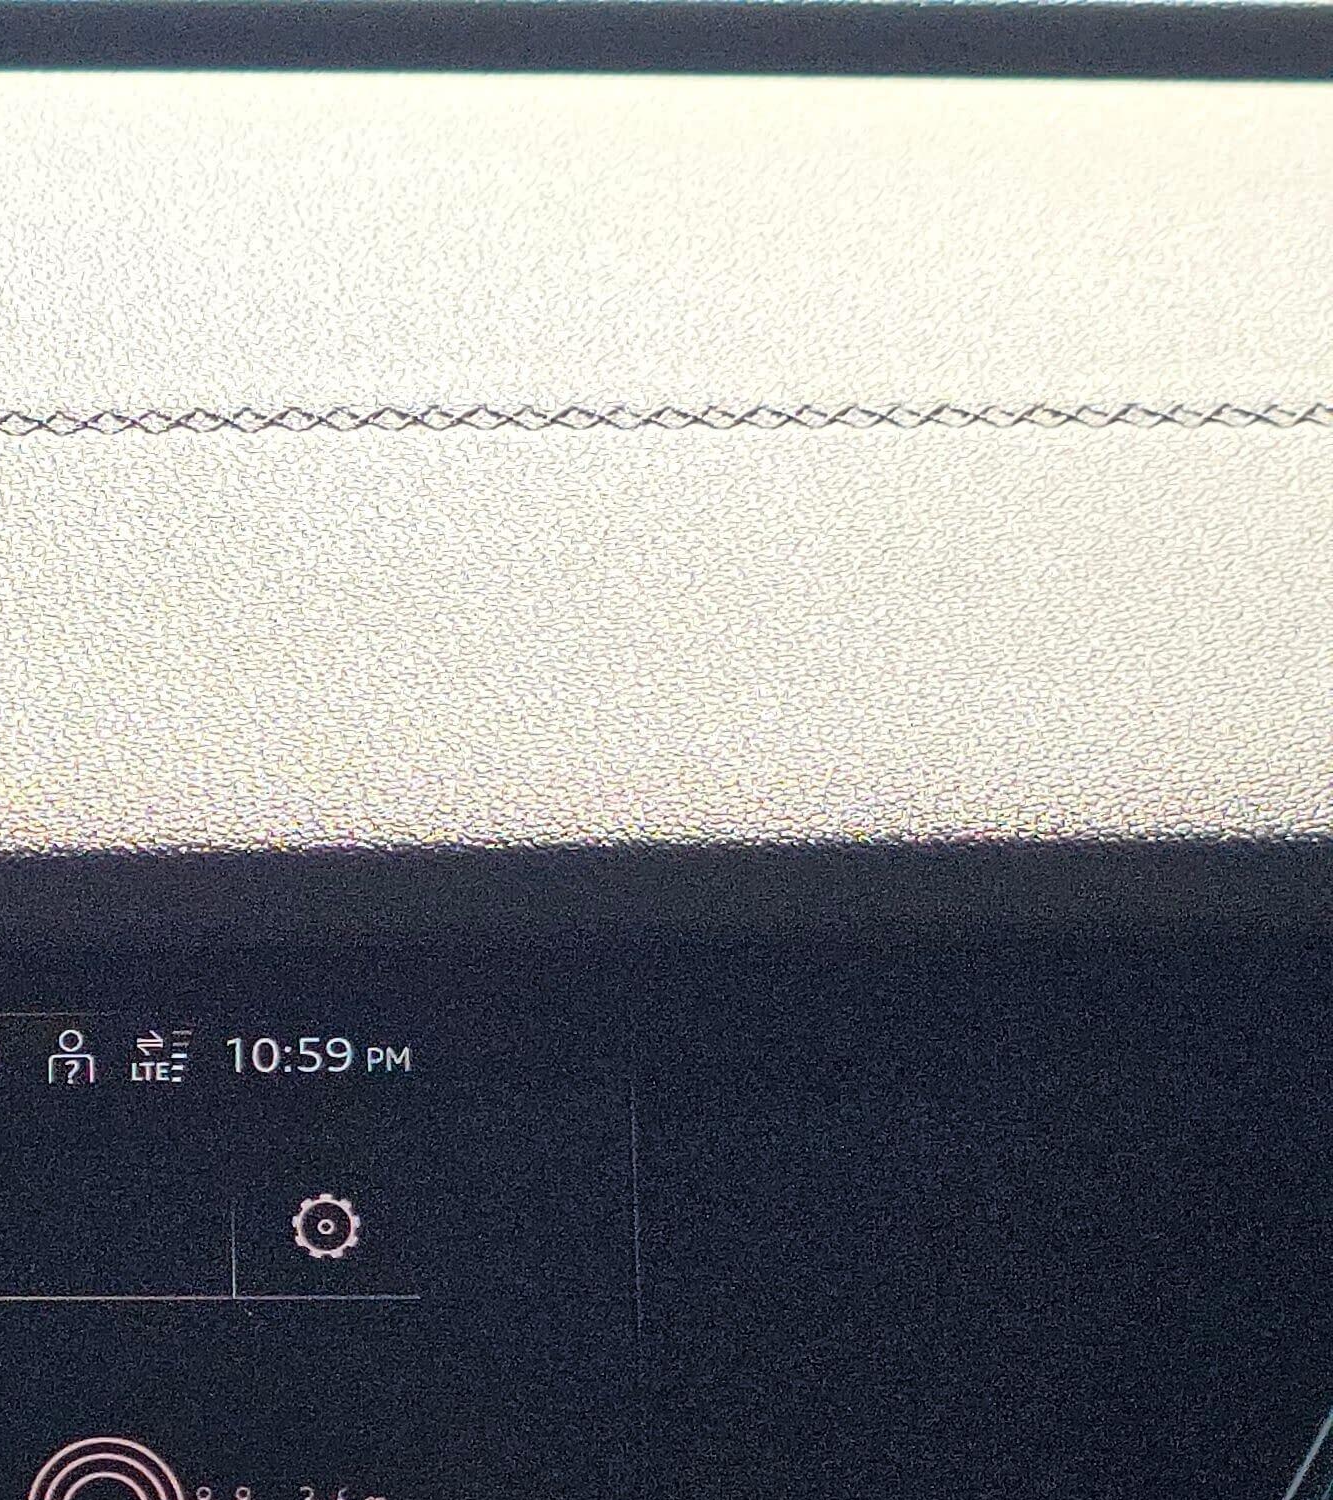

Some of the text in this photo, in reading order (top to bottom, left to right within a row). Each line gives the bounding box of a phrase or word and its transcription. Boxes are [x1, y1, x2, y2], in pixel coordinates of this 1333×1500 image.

[227, 1036, 412, 1073] 10:59 PM
[131, 1061, 169, 1082] LTE
